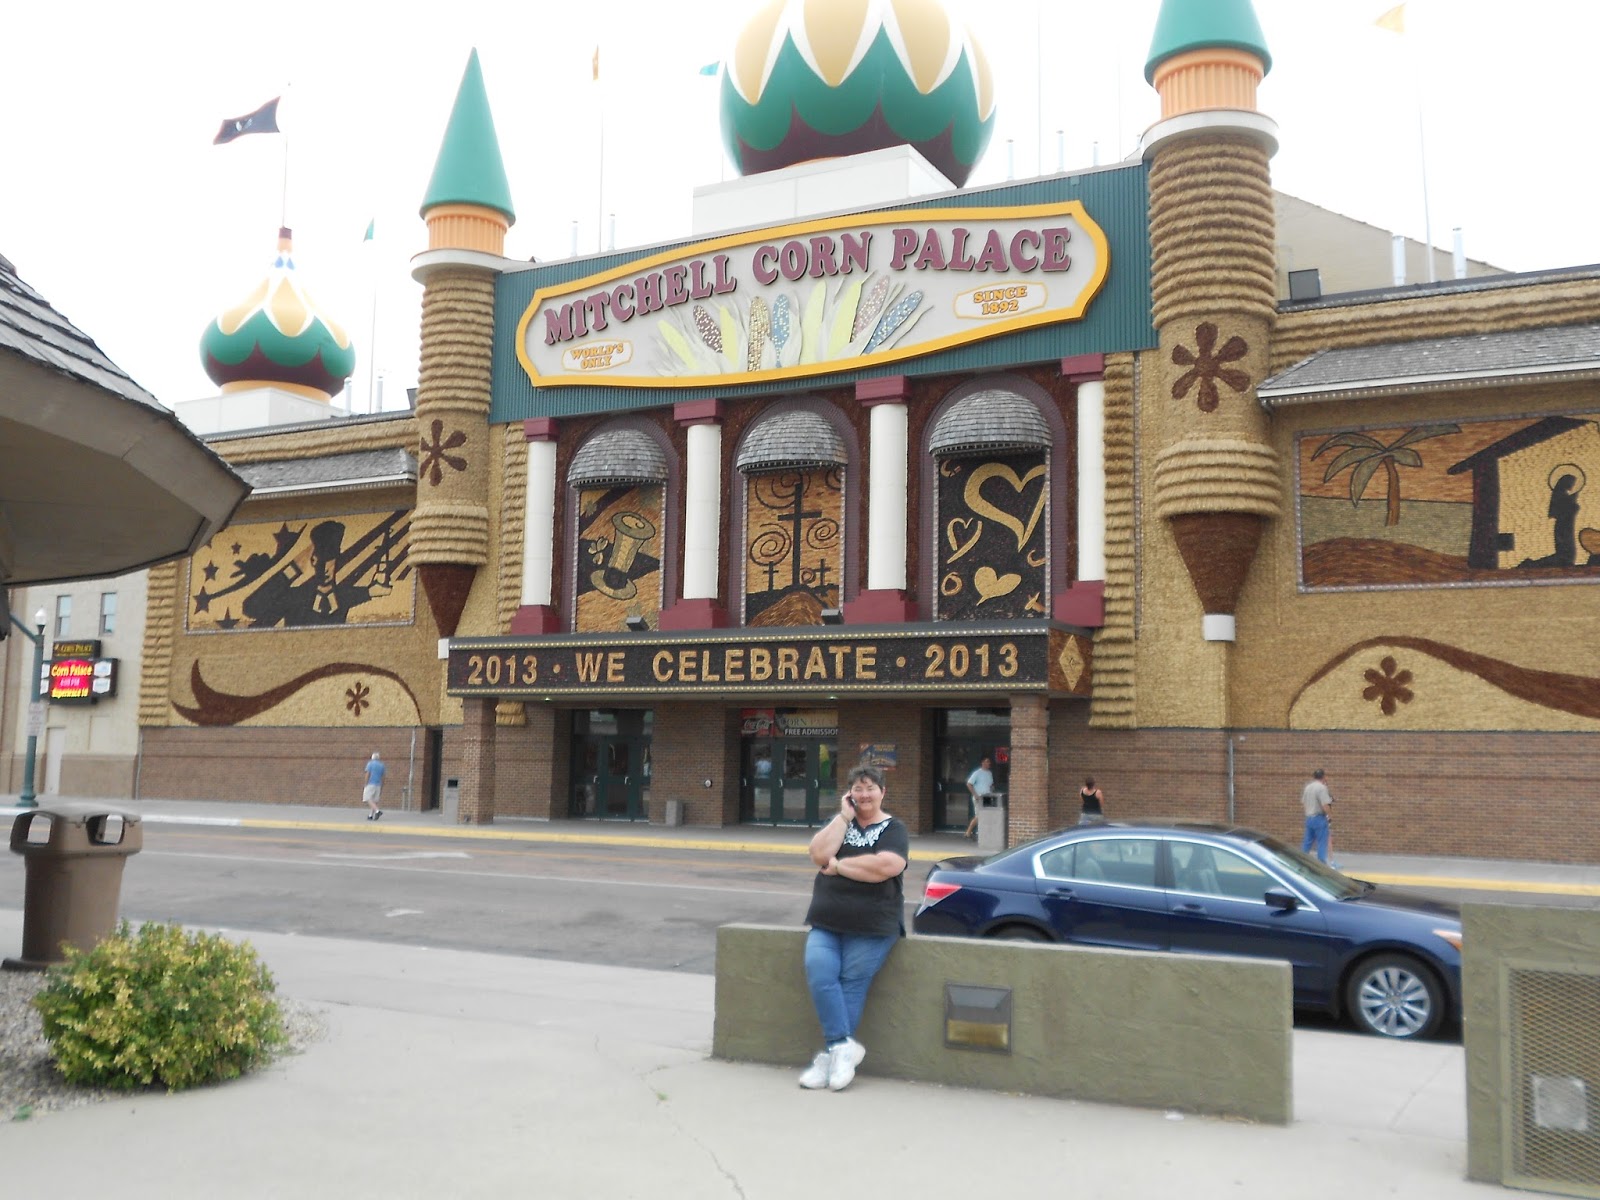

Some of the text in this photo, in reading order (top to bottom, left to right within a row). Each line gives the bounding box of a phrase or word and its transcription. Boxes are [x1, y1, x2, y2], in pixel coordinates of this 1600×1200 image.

[544, 227, 1072, 346] MITCHELL CORN PALACE
[973, 286, 1028, 303] SINCE
[982, 299, 1019, 315] 1892
[570, 342, 624, 360] WORLD'S
[580, 355, 612, 369] ONLY
[467, 642, 1019, 685] 2013 WE CELEBRATE 2013
[784, 728, 801, 736] FREE
